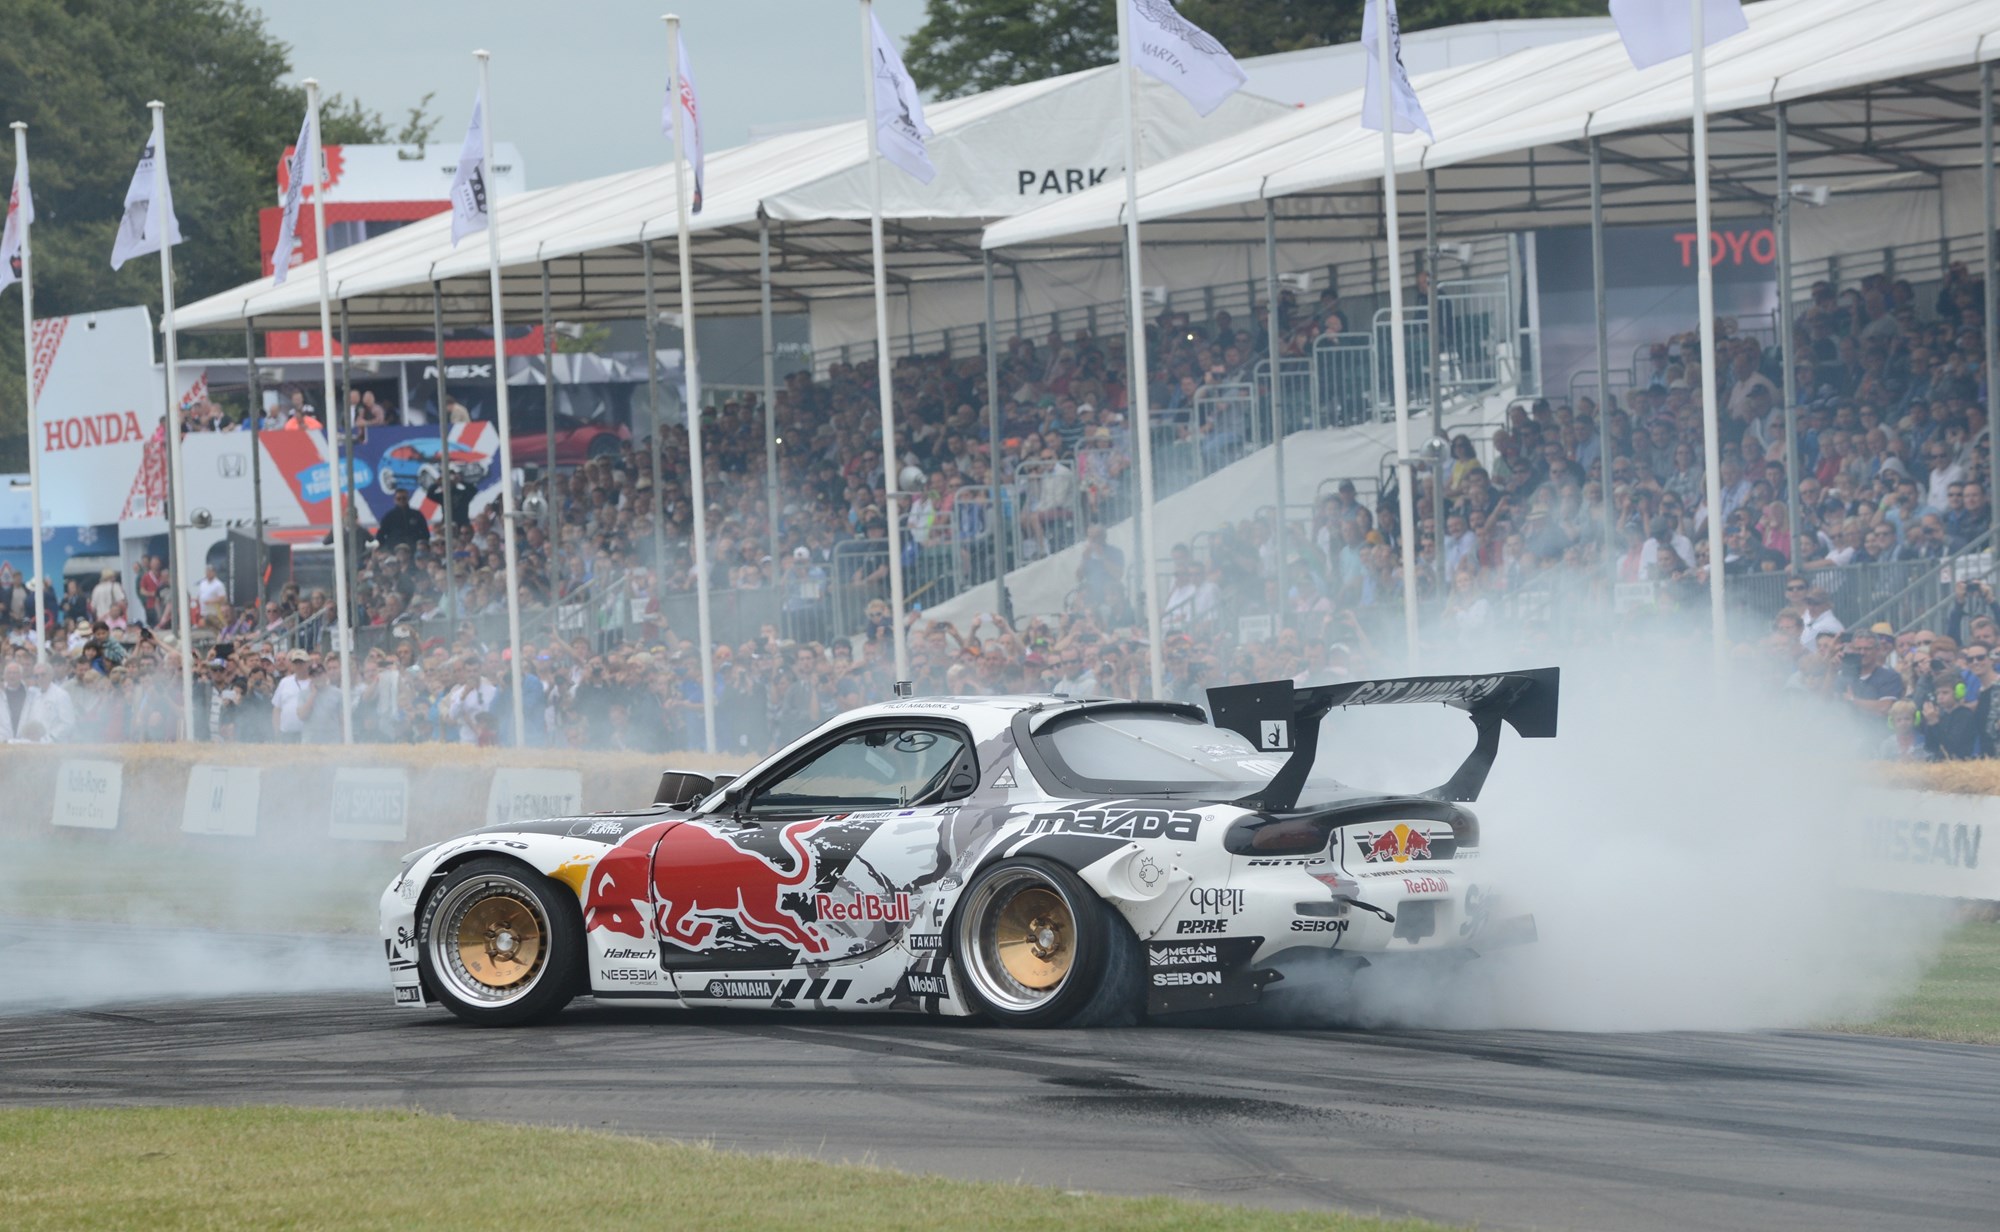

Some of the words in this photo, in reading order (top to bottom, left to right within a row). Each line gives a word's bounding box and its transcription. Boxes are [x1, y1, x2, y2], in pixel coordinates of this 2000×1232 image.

[1018, 167, 1108, 195] PARK
[43, 410, 144, 452] HONDA
[352, 788, 401, 820] SPORTS
[1247, 857, 1327, 867] NITTO
[1402, 877, 1428, 895] Red
[1428, 876, 1449, 894] Bull
[420, 885, 447, 944] NITTO
[815, 892, 864, 921] Red
[864, 892, 911, 922] Bull
[1290, 920, 1350, 933] SEBON
[911, 935, 943, 949] TAKATA
[1168, 945, 1217, 956] MEGAN
[603, 948, 656, 960] Haltech
[1168, 953, 1218, 965] RACING
[907, 975, 938, 995] Mobil
[1152, 970, 1222, 987] SEBON
[723, 981, 773, 998] YAMAHA
